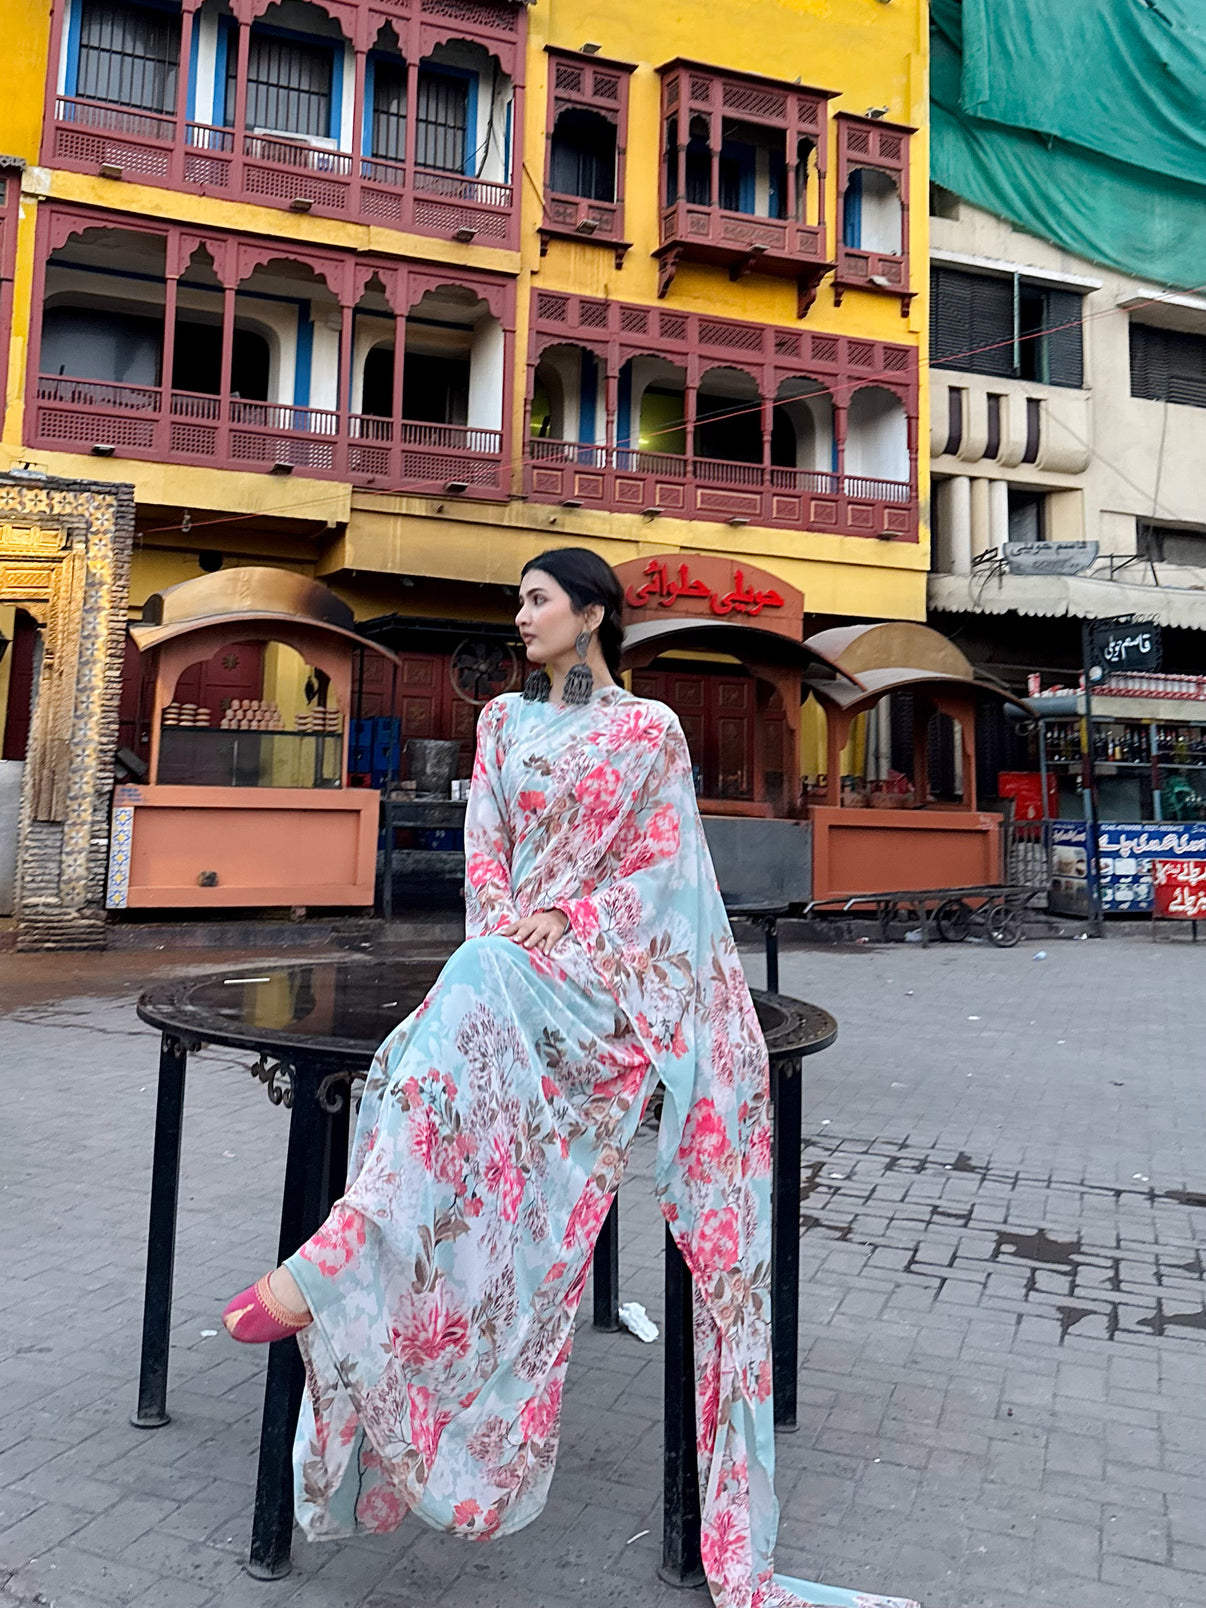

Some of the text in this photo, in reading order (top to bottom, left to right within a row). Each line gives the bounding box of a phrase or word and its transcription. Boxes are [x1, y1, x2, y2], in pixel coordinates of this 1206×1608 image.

[625, 559, 785, 616] حویلی حلوائی
[1104, 632, 1152, 662] قاسم حویلی
